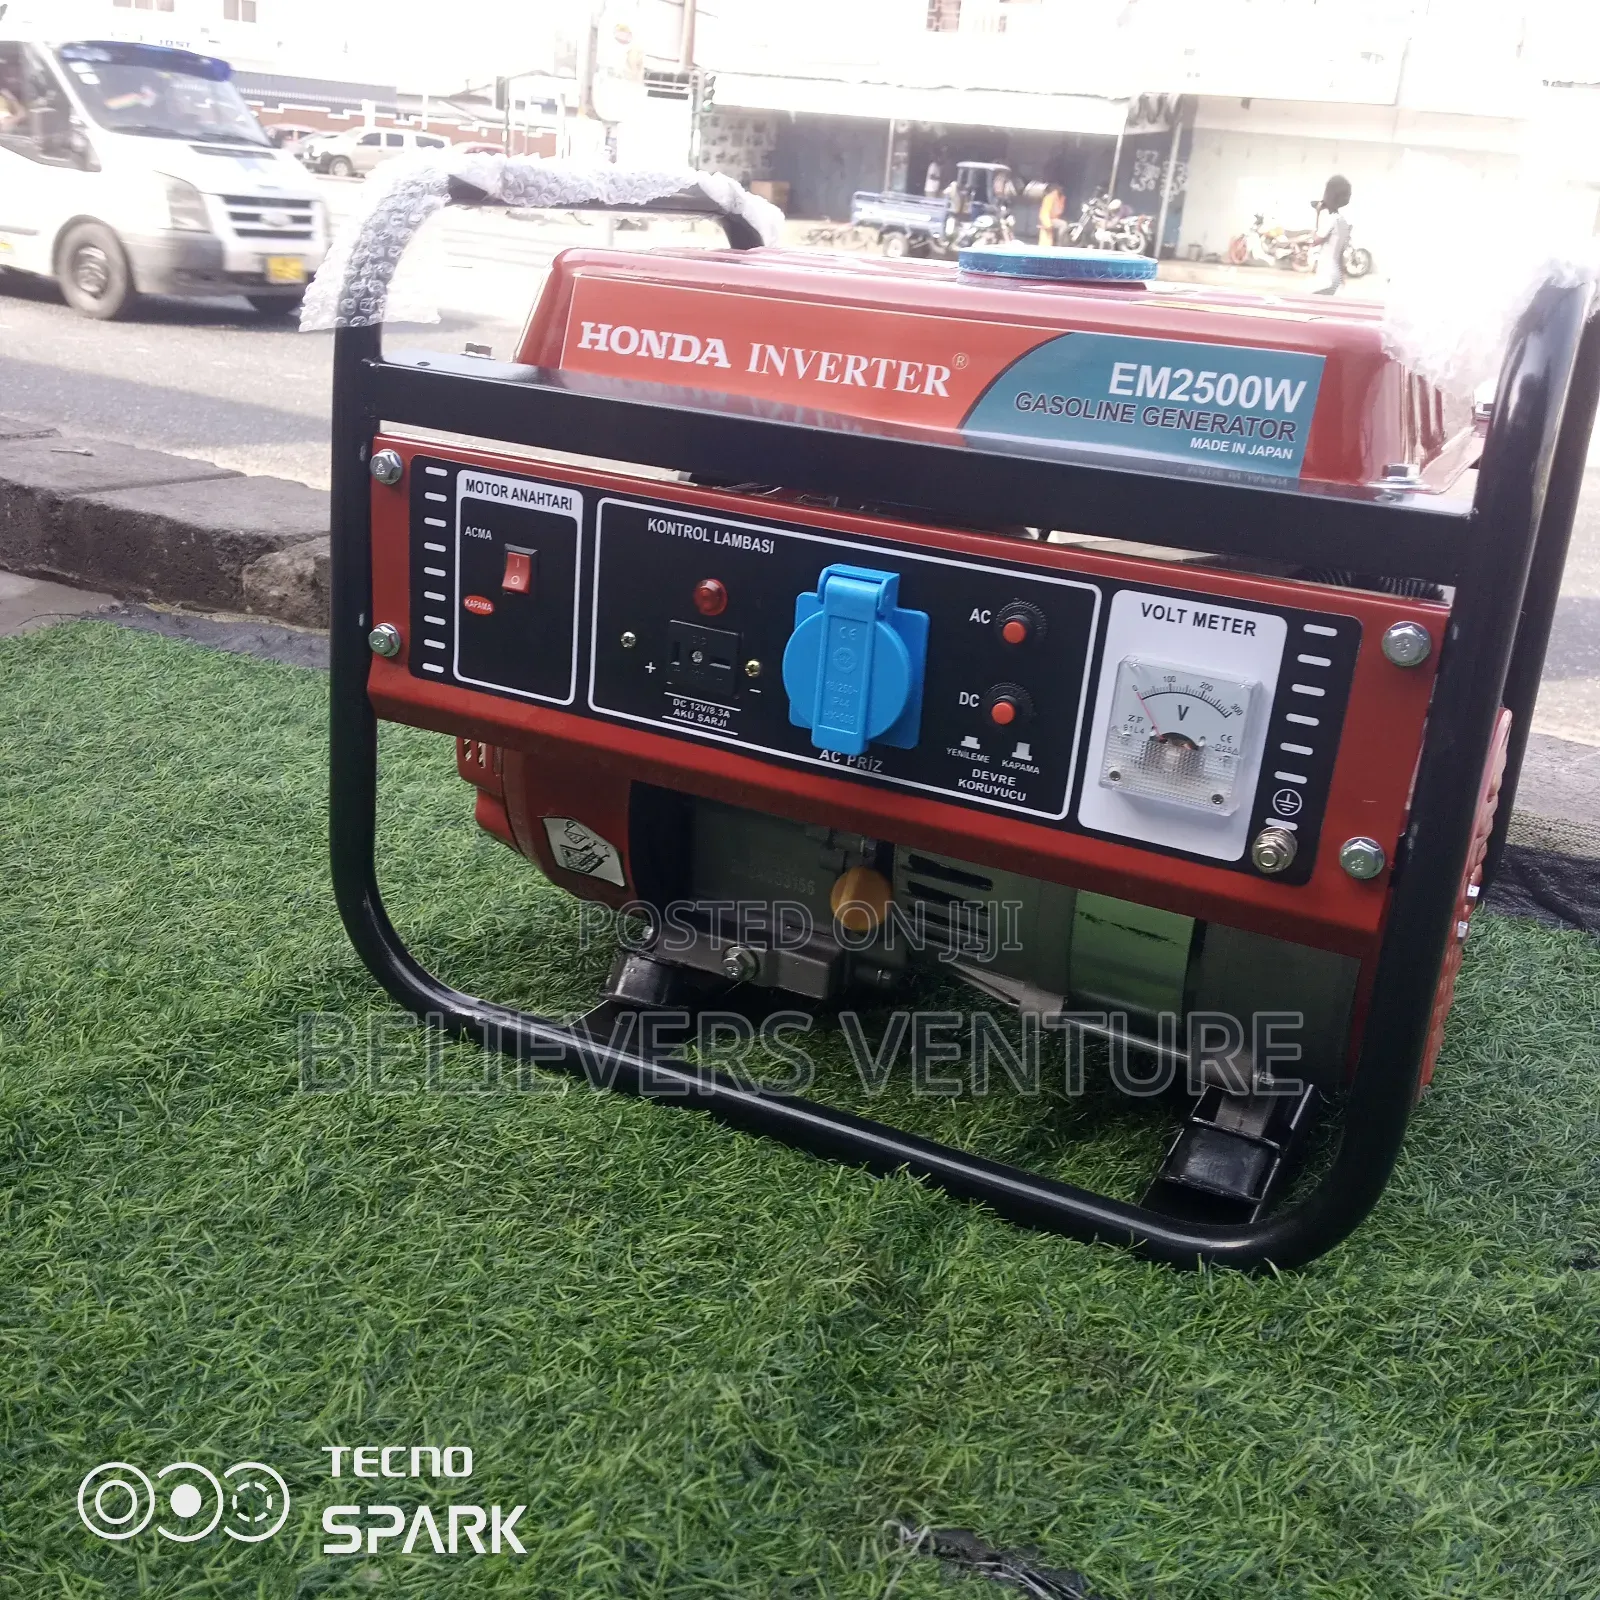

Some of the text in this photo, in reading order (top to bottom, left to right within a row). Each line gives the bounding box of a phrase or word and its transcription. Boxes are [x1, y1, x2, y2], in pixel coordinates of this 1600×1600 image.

[577, 321, 731, 368] HONDA
[745, 342, 951, 397] INVERTER
[1108, 362, 1307, 413] EM2500W
[1015, 391, 1297, 442] GASOLINE GENERATOR
[1190, 437, 1293, 460] MADE IN JAPAN
[465, 478, 573, 511] MOTOR ANAHTARI
[464, 526, 493, 541] ACMA
[647, 517, 774, 554] KONTROL LAMBASI
[464, 598, 493, 612] KAPAMA
[969, 607, 991, 624] AC
[1141, 602, 1257, 637] VOLT METER
[1163, 675, 1176, 683] 100
[1200, 682, 1214, 692] 200
[1132, 684, 1138, 692] 0
[673, 698, 687, 708] DC
[959, 691, 980, 707] DC
[1178, 704, 1190, 721] V
[1230, 703, 1243, 716] 300
[819, 749, 841, 764] AC
[1001, 759, 1040, 775] KAPAMA
[972, 768, 1017, 786] DEVRE
[958, 778, 1027, 802] KORUYUCU
